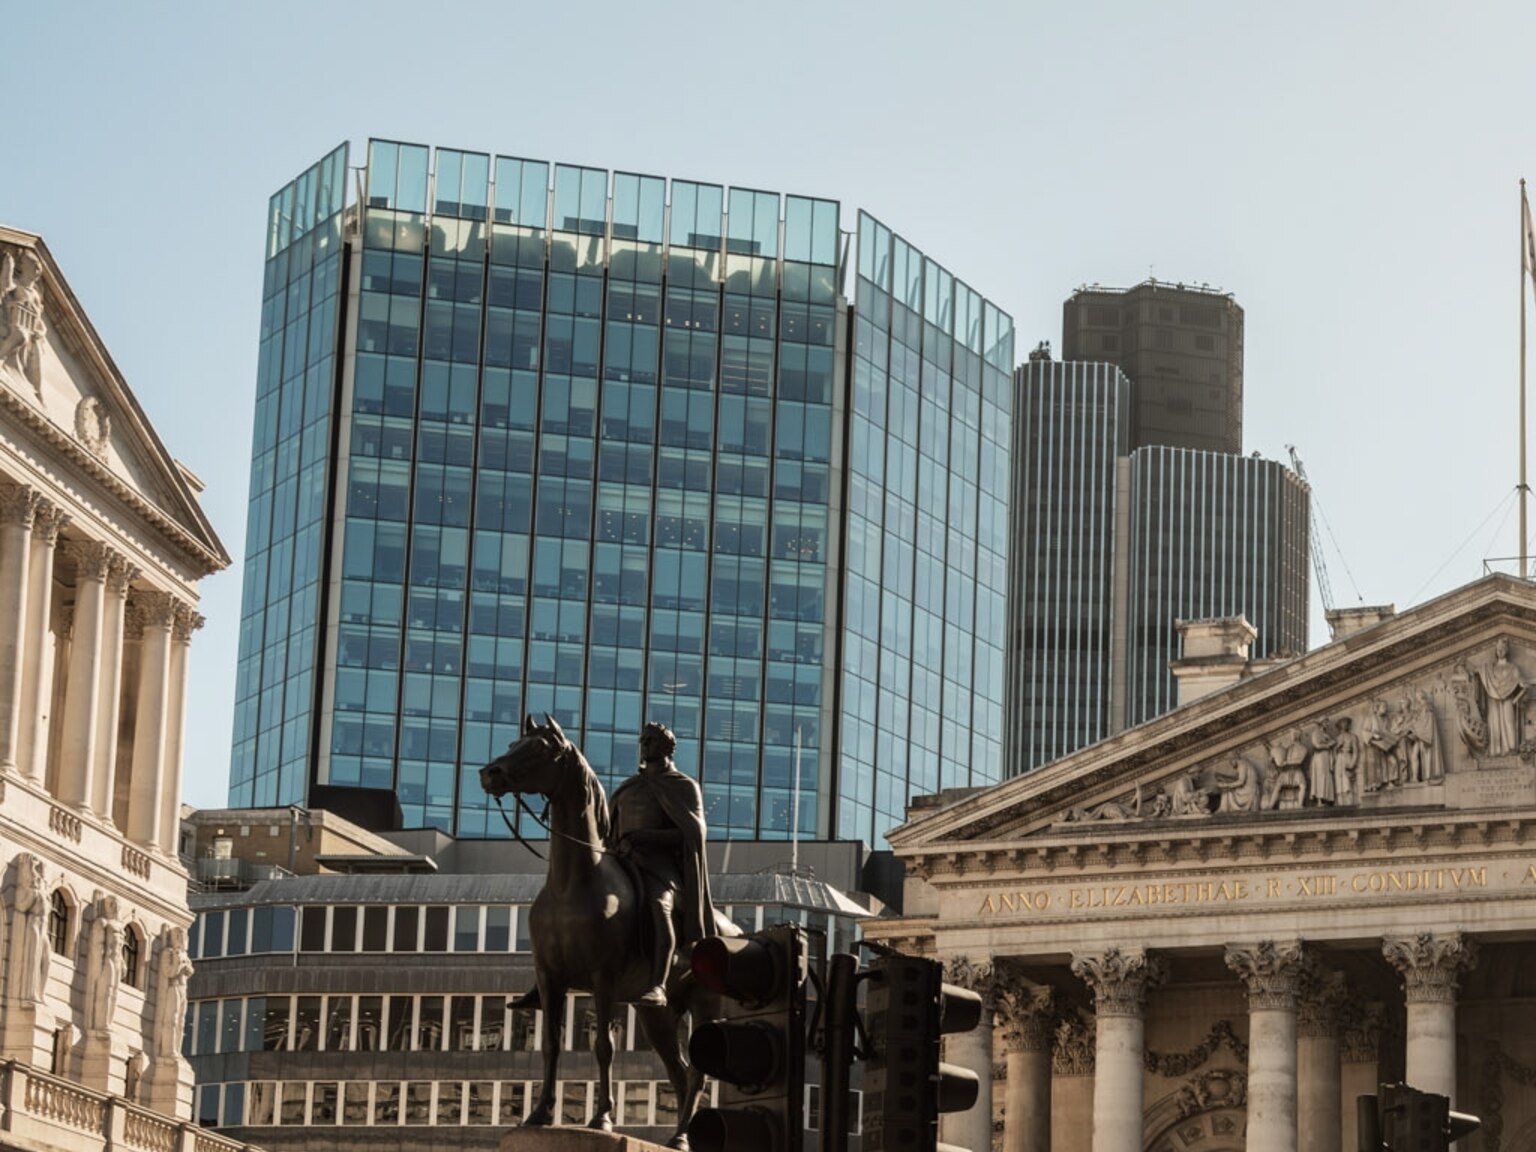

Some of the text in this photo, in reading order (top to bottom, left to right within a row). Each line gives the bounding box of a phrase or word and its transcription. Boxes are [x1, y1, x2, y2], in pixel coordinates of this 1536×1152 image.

[978, 891, 1051, 915] ANNO
[1068, 879, 1249, 909] ELIZABETHAE
[1266, 877, 1282, 898] R
[1296, 874, 1338, 897] XIII
[1350, 866, 1488, 893] CONDITVM
